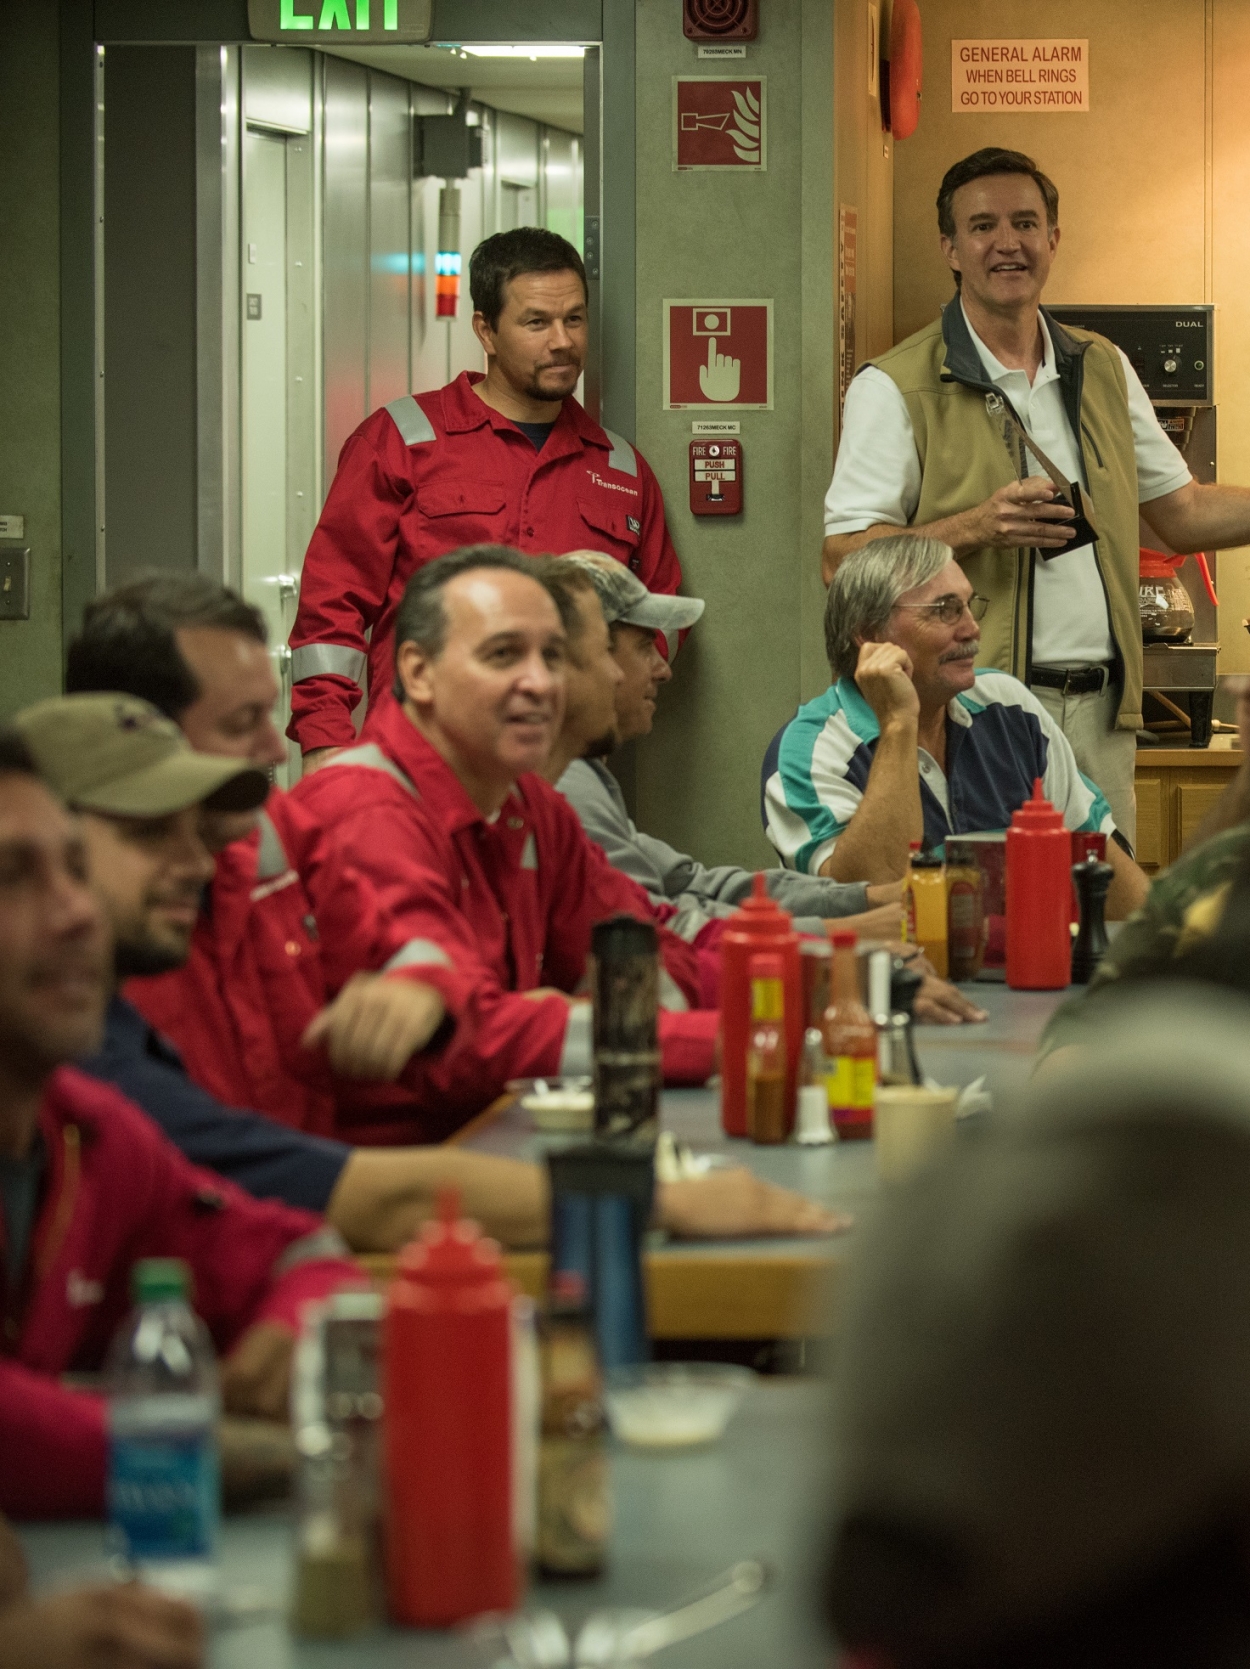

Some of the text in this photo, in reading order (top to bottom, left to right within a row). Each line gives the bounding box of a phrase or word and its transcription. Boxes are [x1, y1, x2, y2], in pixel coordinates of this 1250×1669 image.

[960, 46, 1082, 62] GENERAL ALARM
[966, 68, 1077, 83] WHEN BELL RINGS
[960, 90, 1082, 105] GO TO YOUR STATION
[693, 447, 737, 456] FIRE FIRE
[705, 472, 726, 480] PULL
[596, 478, 638, 496] Transocean
